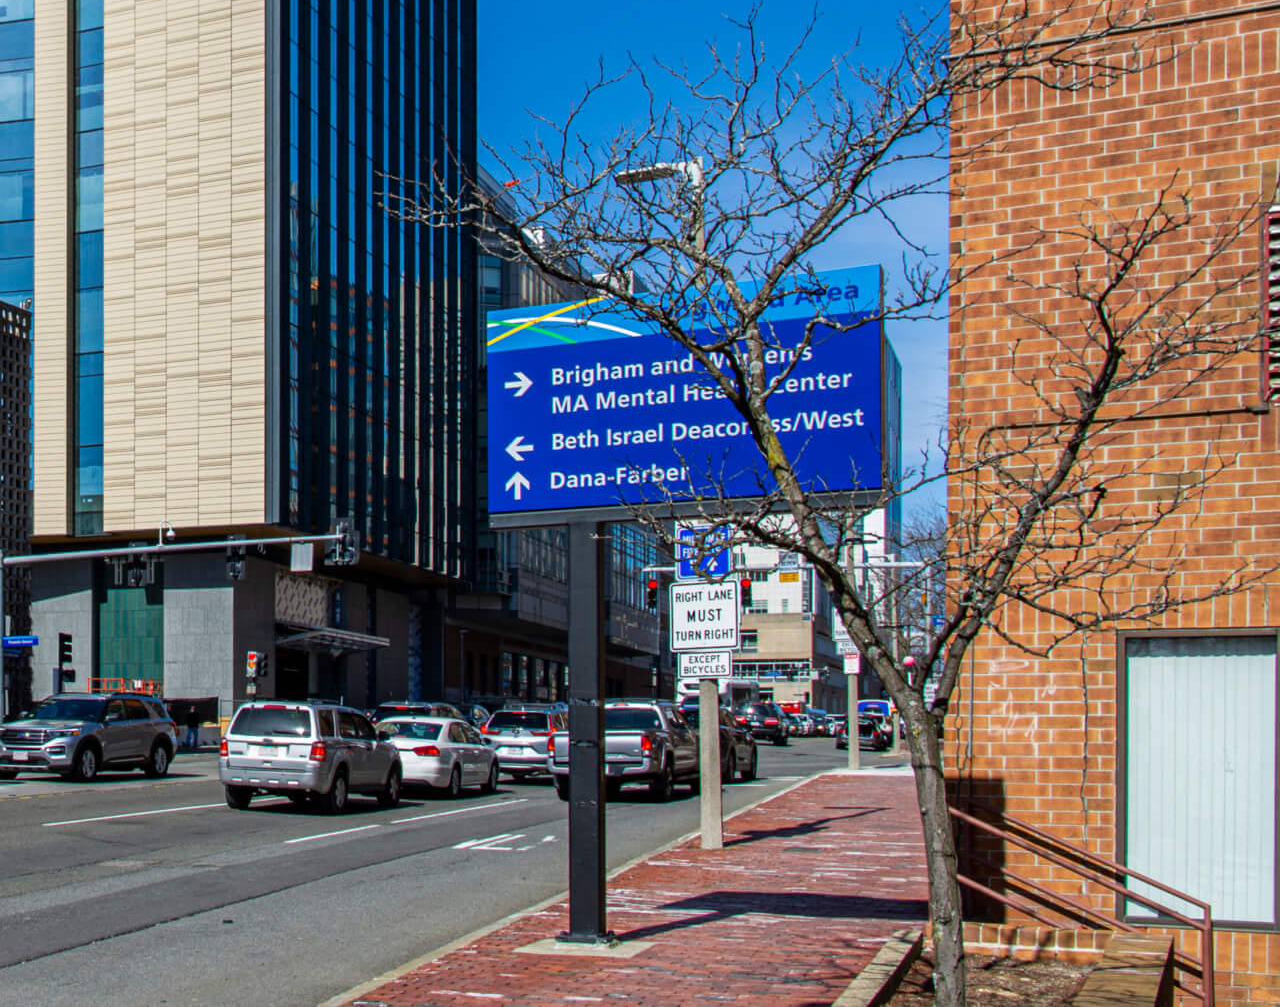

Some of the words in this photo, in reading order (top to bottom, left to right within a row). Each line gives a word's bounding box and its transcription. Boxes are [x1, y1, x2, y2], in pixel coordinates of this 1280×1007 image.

[551, 362, 644, 387] Brigham
[651, 353, 694, 376] and
[551, 395, 589, 415] MA
[596, 384, 675, 410] Mental
[552, 429, 599, 450] Beth
[606, 423, 664, 446] Israel
[671, 409, 864, 441] Deaconss/West
[550, 463, 690, 489] Dana-Farber
[675, 591, 703, 603] RIGHT
[708, 589, 734, 601] LANE
[687, 608, 722, 623] MUST
[676, 630, 702, 642] TURN
[704, 628, 734, 640] RIGHT
[688, 654, 721, 664] EXCEPT
[683, 664, 727, 674] BICYCLES
